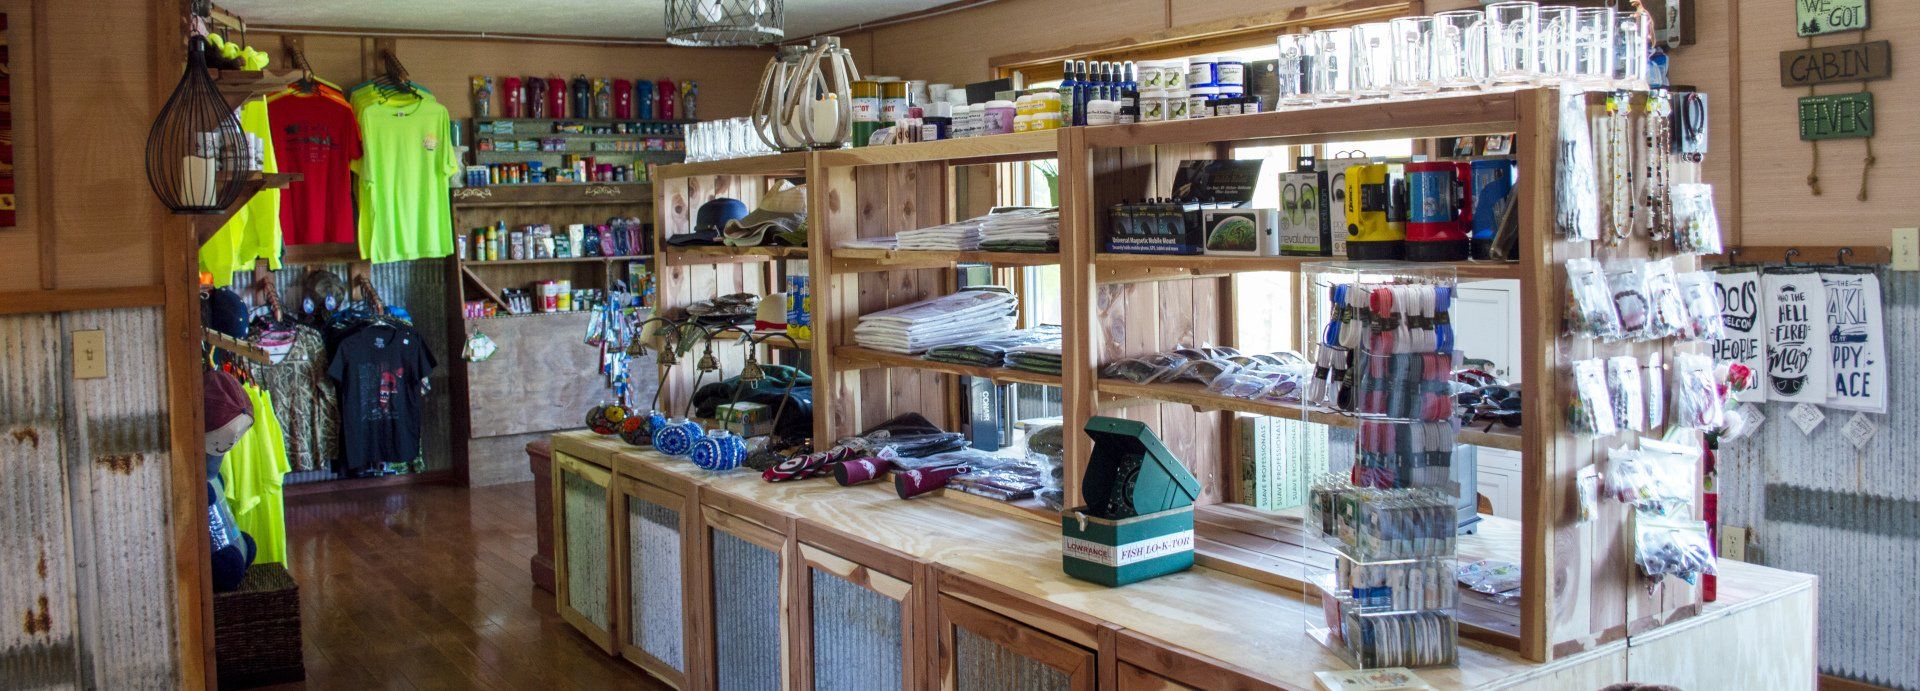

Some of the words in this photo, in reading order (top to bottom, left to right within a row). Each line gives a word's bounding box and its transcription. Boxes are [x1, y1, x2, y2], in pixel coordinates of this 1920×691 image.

[1804, 0, 1831, 13] WE
[1829, 5, 1862, 27] GOT
[1790, 47, 1870, 82] CABIN
[1801, 100, 1869, 136] FEVER
[1280, 233, 1319, 244] revolution
[1790, 292, 1806, 302] THE
[1778, 304, 1808, 323] HELL
[1775, 324, 1808, 342] FIRED
[1833, 346, 1863, 369] PPY
[1835, 372, 1871, 397] ACE
[1066, 541, 1108, 559] LOWRANCE
[1121, 548, 1144, 560] FISH
[1145, 536, 1190, 555] LO-K-TOR
